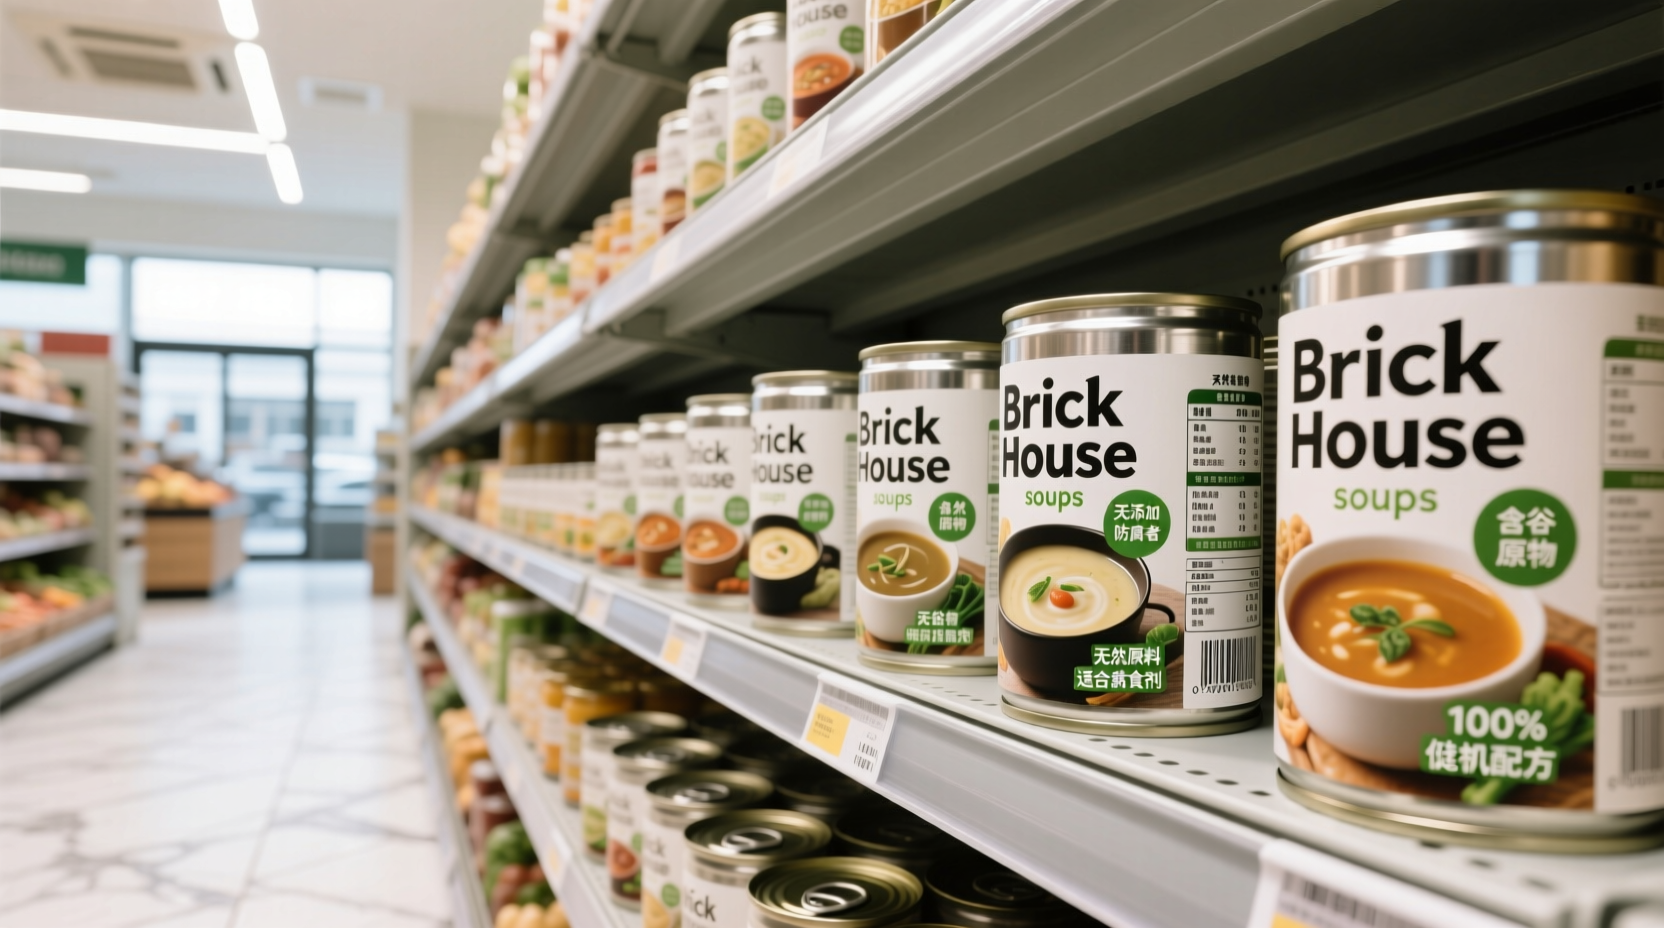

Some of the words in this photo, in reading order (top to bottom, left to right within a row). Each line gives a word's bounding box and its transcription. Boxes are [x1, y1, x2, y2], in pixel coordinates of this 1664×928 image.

[1293, 318, 1502, 403] Brick
[1003, 375, 1124, 431] Brick
[860, 405, 941, 446] Brick
[1291, 410, 1526, 469] House
[858, 451, 951, 484] House
[1002, 436, 1137, 479] House
[1025, 490, 1084, 512] soups
[1333, 487, 1438, 519] soups
[1447, 704, 1548, 742] 100%
